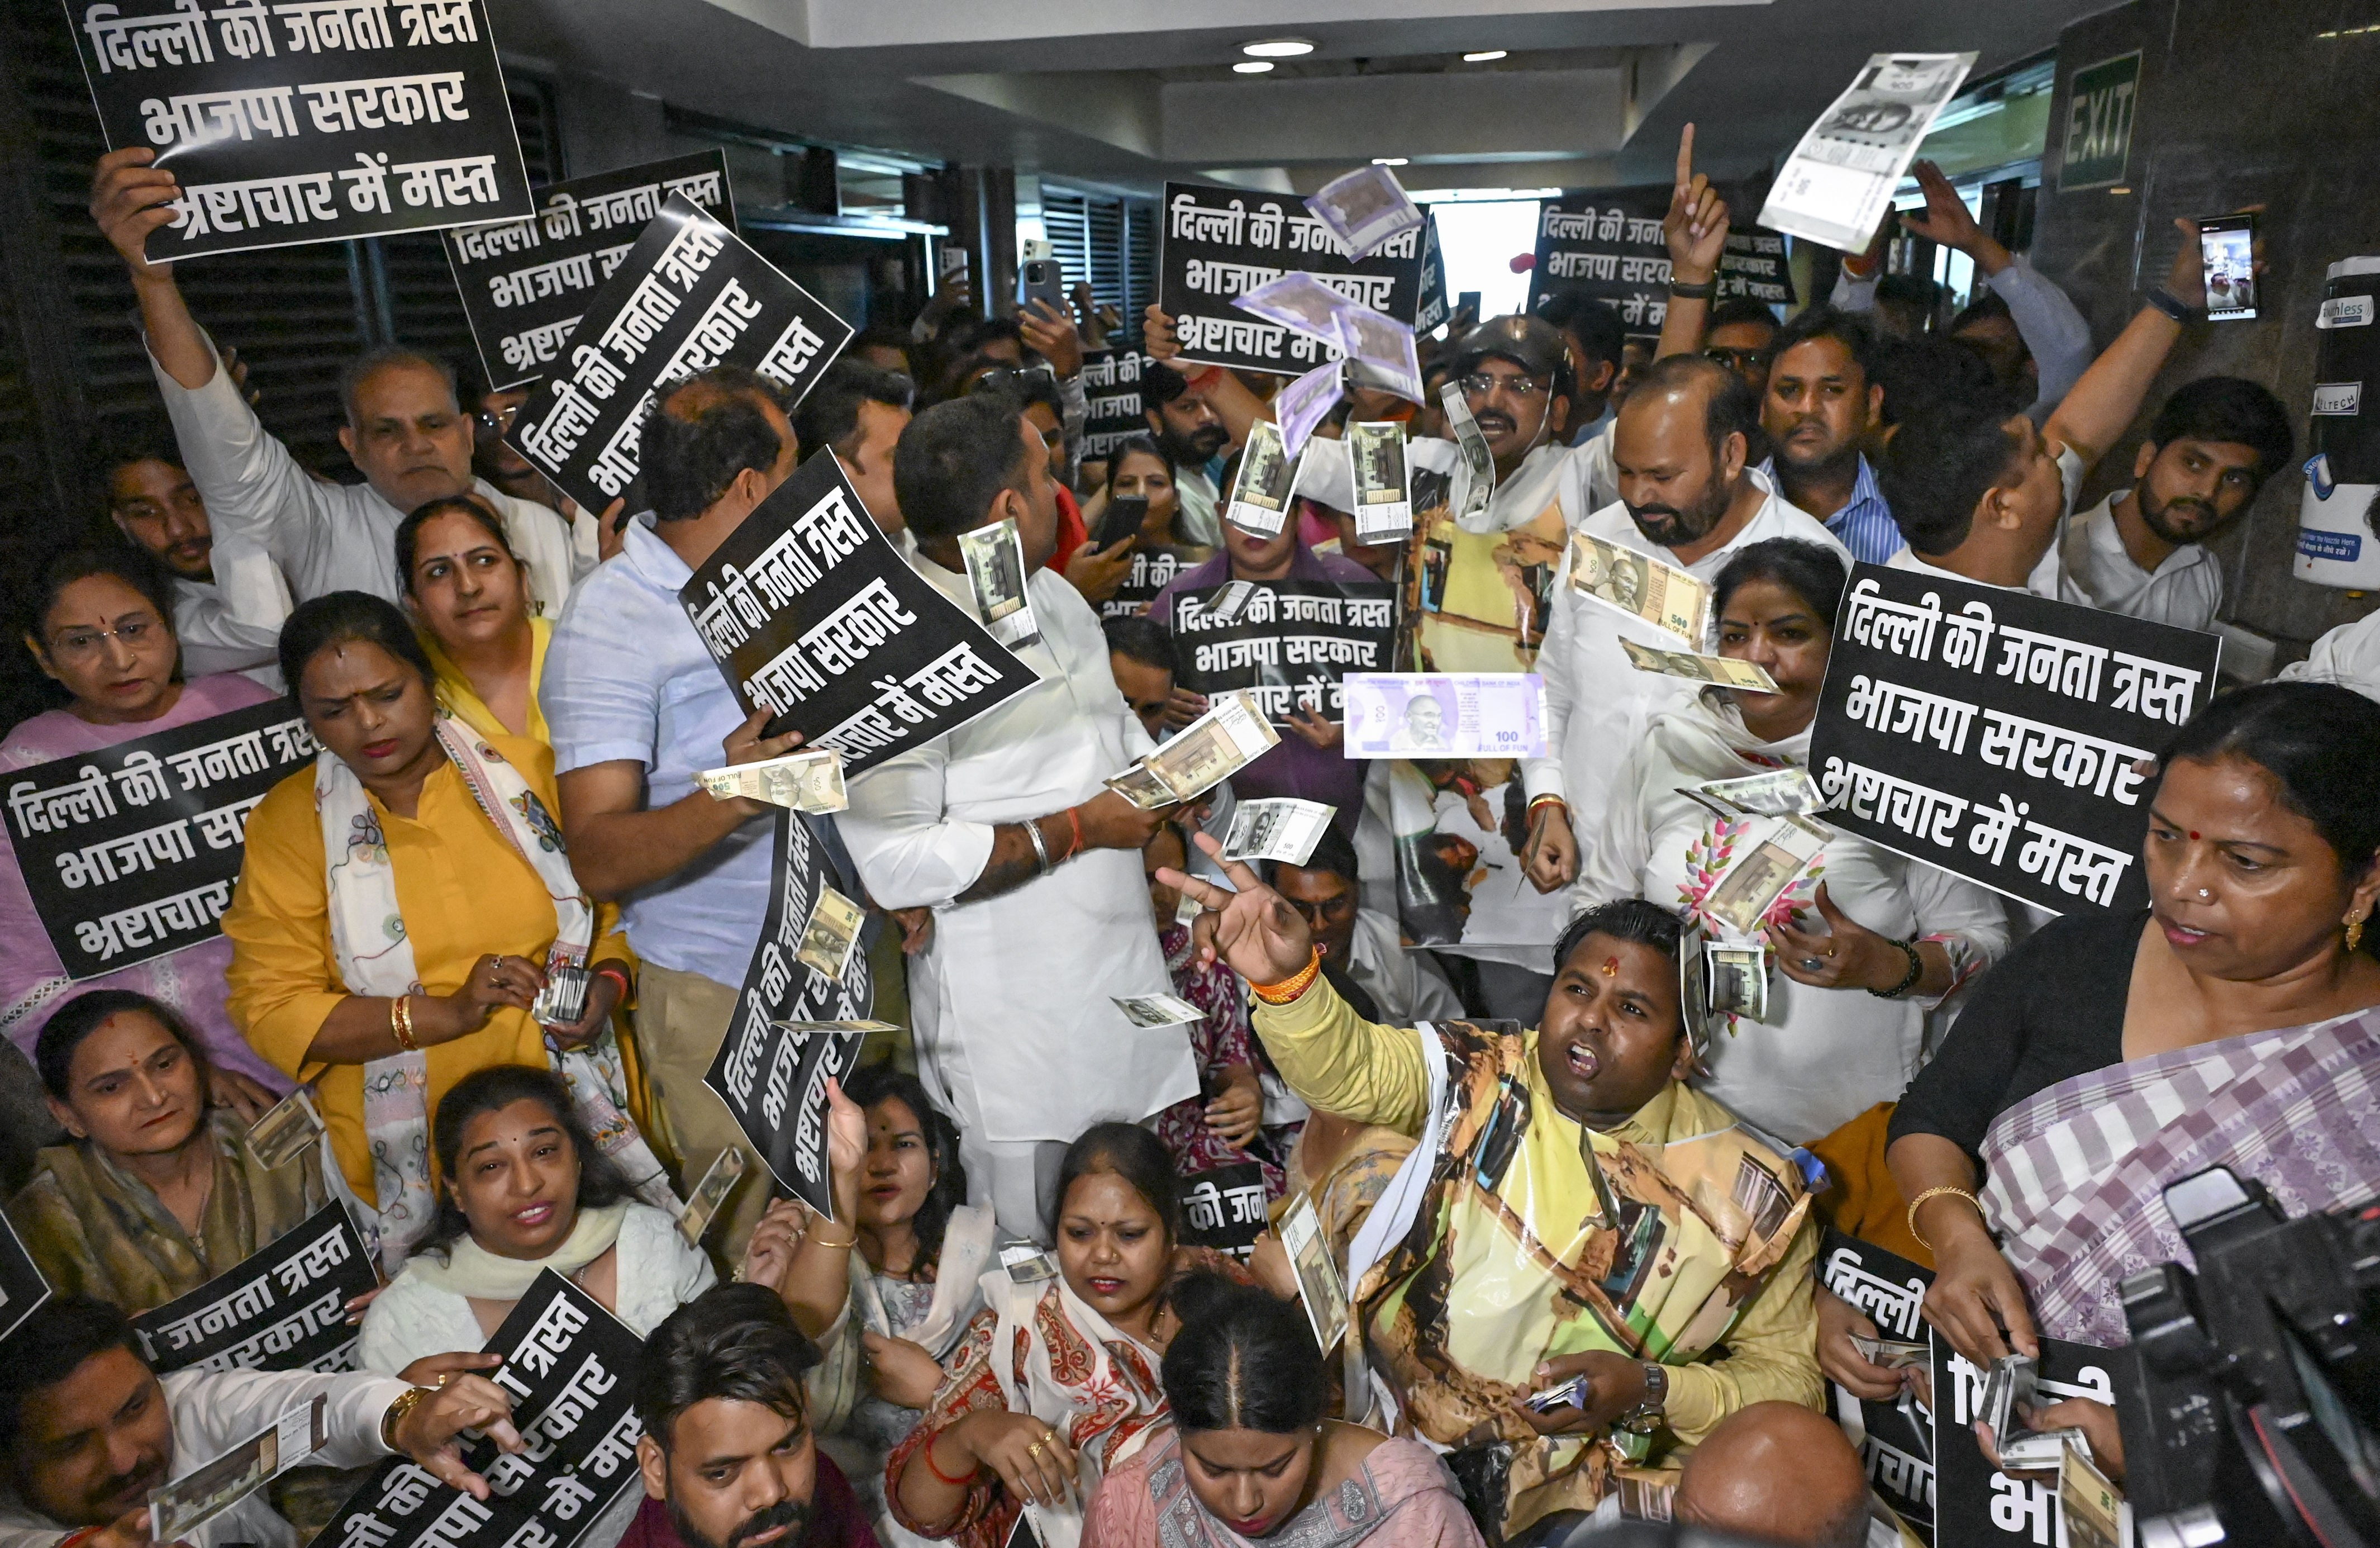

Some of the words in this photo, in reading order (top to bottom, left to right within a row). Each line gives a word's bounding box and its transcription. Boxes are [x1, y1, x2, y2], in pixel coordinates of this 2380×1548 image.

[84, 2, 215, 73] दिल्ली
[212, 0, 276, 60] की
[275, 1, 394, 54] जनता
[400, 0, 479, 46] त्रस्त
[140, 86, 299, 146] भाजपा
[299, 72, 469, 134] सरकार
[2063, 82, 2134, 165] EXIT
[167, 172, 339, 241] भ्रष्टाचार
[338, 152, 391, 219] में
[391, 155, 499, 208] मस्त
[540, 193, 582, 241] की
[581, 184, 661, 233] जनता
[1170, 194, 1246, 246] दिल्ली
[1248, 202, 1285, 251] की
[1541, 205, 1597, 241] दिल्ली
[1597, 208, 1625, 243] की
[489, 253, 596, 308] भाजपा
[653, 213, 726, 293] त्रस्त
[1548, 251, 1619, 280] भाजपा
[598, 273, 682, 364] जनता
[1176, 314, 1286, 360] भ्रष्टाचार
[1622, 292, 1650, 326] में
[570, 344, 628, 401] की
[1117, 351, 1141, 383] की
[520, 378, 601, 474] दिल्ली
[793, 485, 870, 571] त्रस्त
[721, 563, 772, 631] की
[743, 530, 823, 609] जनता
[1149, 552, 1177, 588] की
[688, 581, 748, 664] दिल्ली
[1246, 587, 1278, 625] की
[1278, 594, 1343, 625] जनता
[1344, 597, 1393, 628] त्रस्त
[1658, 618, 1672, 631] FULL
[1681, 628, 1693, 641] FUN
[1671, 614, 1688, 629] 500
[742, 642, 827, 718] भाजपा
[798, 576, 917, 676] सरकार
[902, 640, 1003, 708] मस्त
[1195, 637, 1280, 672] भाजपा
[1283, 635, 1378, 667] सरकार
[1843, 578, 1943, 662] दिल्ली
[1940, 600, 1997, 675] की
[1995, 623, 2110, 704] जनता
[2109, 649, 2202, 727] त्रस्त
[871, 675, 936, 724] में
[1294, 675, 1324, 714] में
[1260, 743, 1270, 752] 500
[1479, 744, 1498, 752] FULL
[1500, 744, 1511, 752] OF
[1513, 744, 1529, 752] FUN
[1495, 731, 1519, 743] 100
[1845, 673, 1979, 756] भाजपा
[1979, 707, 2159, 807] सरकार
[7, 764, 117, 838] दिल्ली
[112, 749, 171, 807] की
[166, 728, 269, 791] जनता
[713, 782, 731, 791] 500
[727, 772, 742, 781] FULL
[55, 819, 196, 889] भाजपा
[787, 809, 811, 884] त्रस्त
[1821, 755, 1970, 849] भ्रष्टाचार
[1967, 792, 2032, 867] में
[2017, 823, 2134, 909] मस्त
[75, 883, 230, 961] भ्रष्टाचार
[777, 861, 808, 963] जनता
[759, 941, 793, 1008] की
[723, 985, 772, 1114] दिल्ली
[1183, 1181, 1226, 1231] की
[157, 1274, 275, 1351] जनता
[272, 1222, 351, 1297] त्रस्त
[1824, 1247, 1929, 1340] दिल्ली
[376, 1461, 444, 1517] की
[508, 1289, 590, 1380] त्रस्त
[486, 1352, 619, 1497] सरकार
[540, 1463, 598, 1521] में
